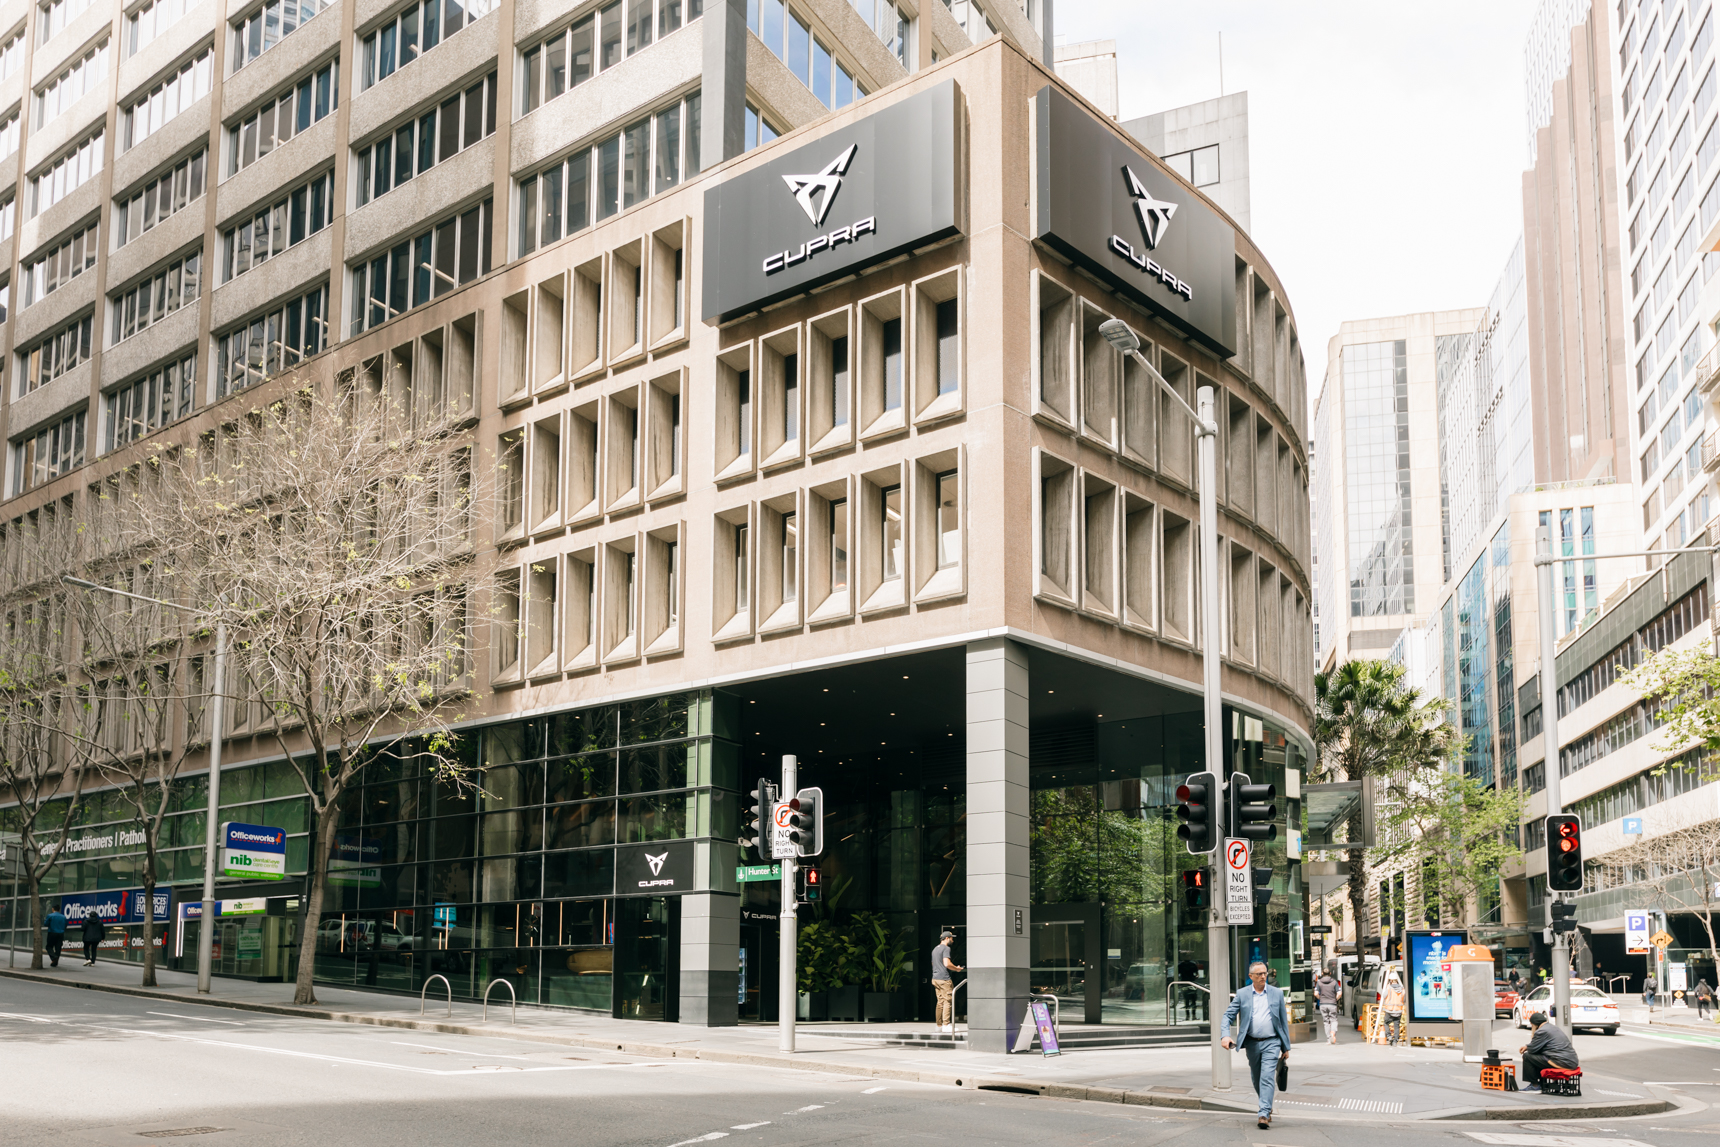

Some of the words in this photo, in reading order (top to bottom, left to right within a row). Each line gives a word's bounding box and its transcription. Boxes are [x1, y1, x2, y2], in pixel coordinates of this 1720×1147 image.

[763, 216, 875, 272] CUPRA
[1112, 234, 1192, 300] CUPRA
[230, 830, 275, 843] Officeworks
[778, 829, 790, 839] NO
[66, 835, 114, 853] Practitioners
[230, 854, 252, 866] nib
[748, 867, 770, 876] Hunter
[771, 866, 779, 875] St
[1232, 872, 1245, 883] NO
[638, 879, 674, 888] CUPRA
[1230, 885, 1248, 893] RIGHT
[154, 905, 165, 915] DAY
[1631, 917, 1643, 930] P
